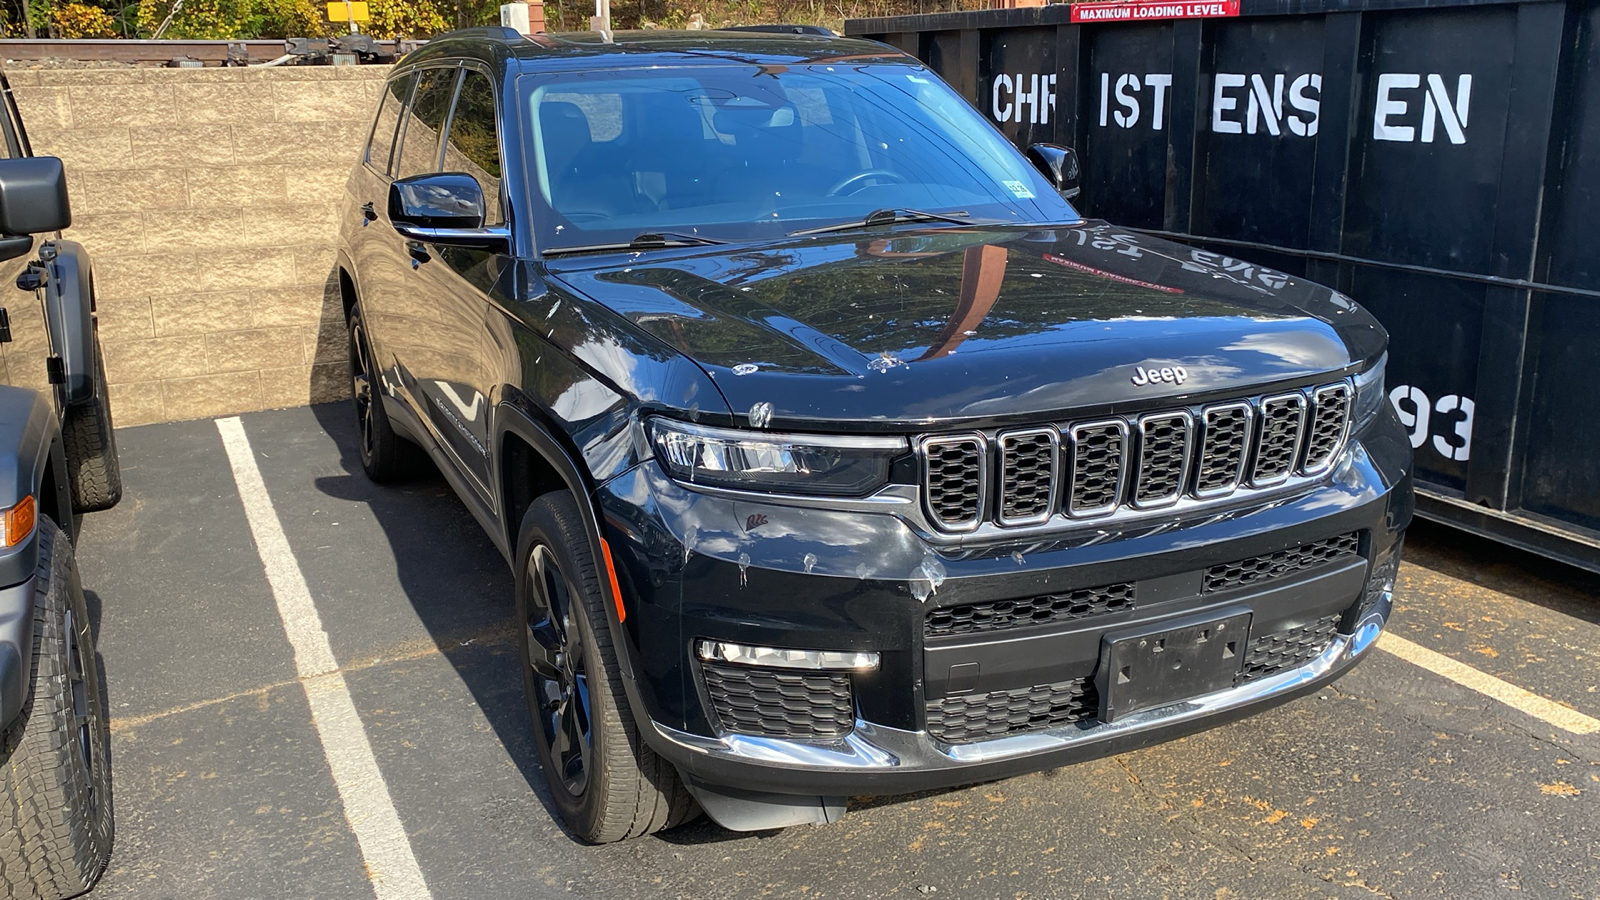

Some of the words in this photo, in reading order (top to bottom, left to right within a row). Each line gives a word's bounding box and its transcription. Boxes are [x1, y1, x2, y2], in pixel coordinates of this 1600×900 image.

[1080, 8, 1130, 20] MAXIMUM
[1133, 6, 1184, 18] LOADING
[1186, 4, 1226, 16] LEVEL
[1130, 366, 1188, 386] Jeep
[1388, 384, 1475, 462] 93
